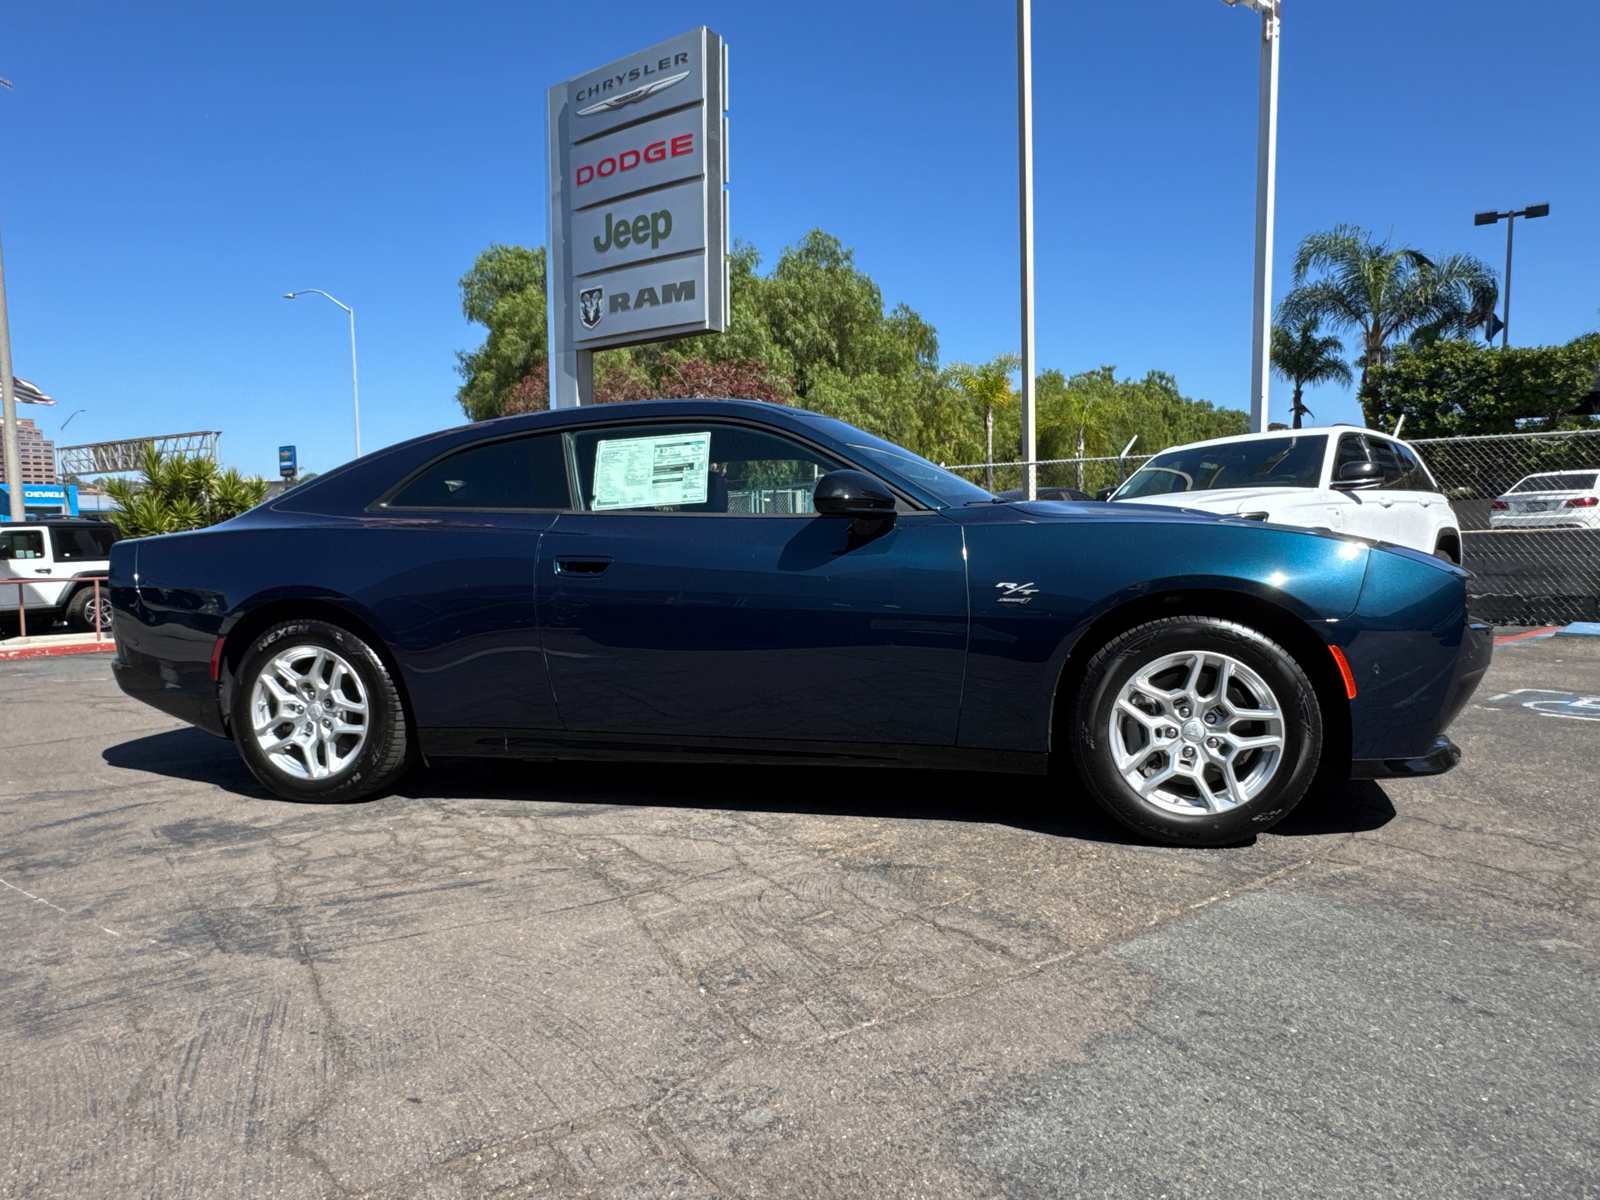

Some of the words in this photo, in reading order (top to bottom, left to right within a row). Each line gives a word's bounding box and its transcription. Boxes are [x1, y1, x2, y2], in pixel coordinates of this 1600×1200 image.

[576, 52, 689, 102] CHRYSLER
[576, 134, 693, 187] DODGE
[594, 209, 672, 252] Jeep
[609, 280, 695, 315] RAM
[25, 490, 65, 498] CHEVROLE
[995, 582, 1040, 596] R/T
[257, 624, 310, 651] NEXEN
